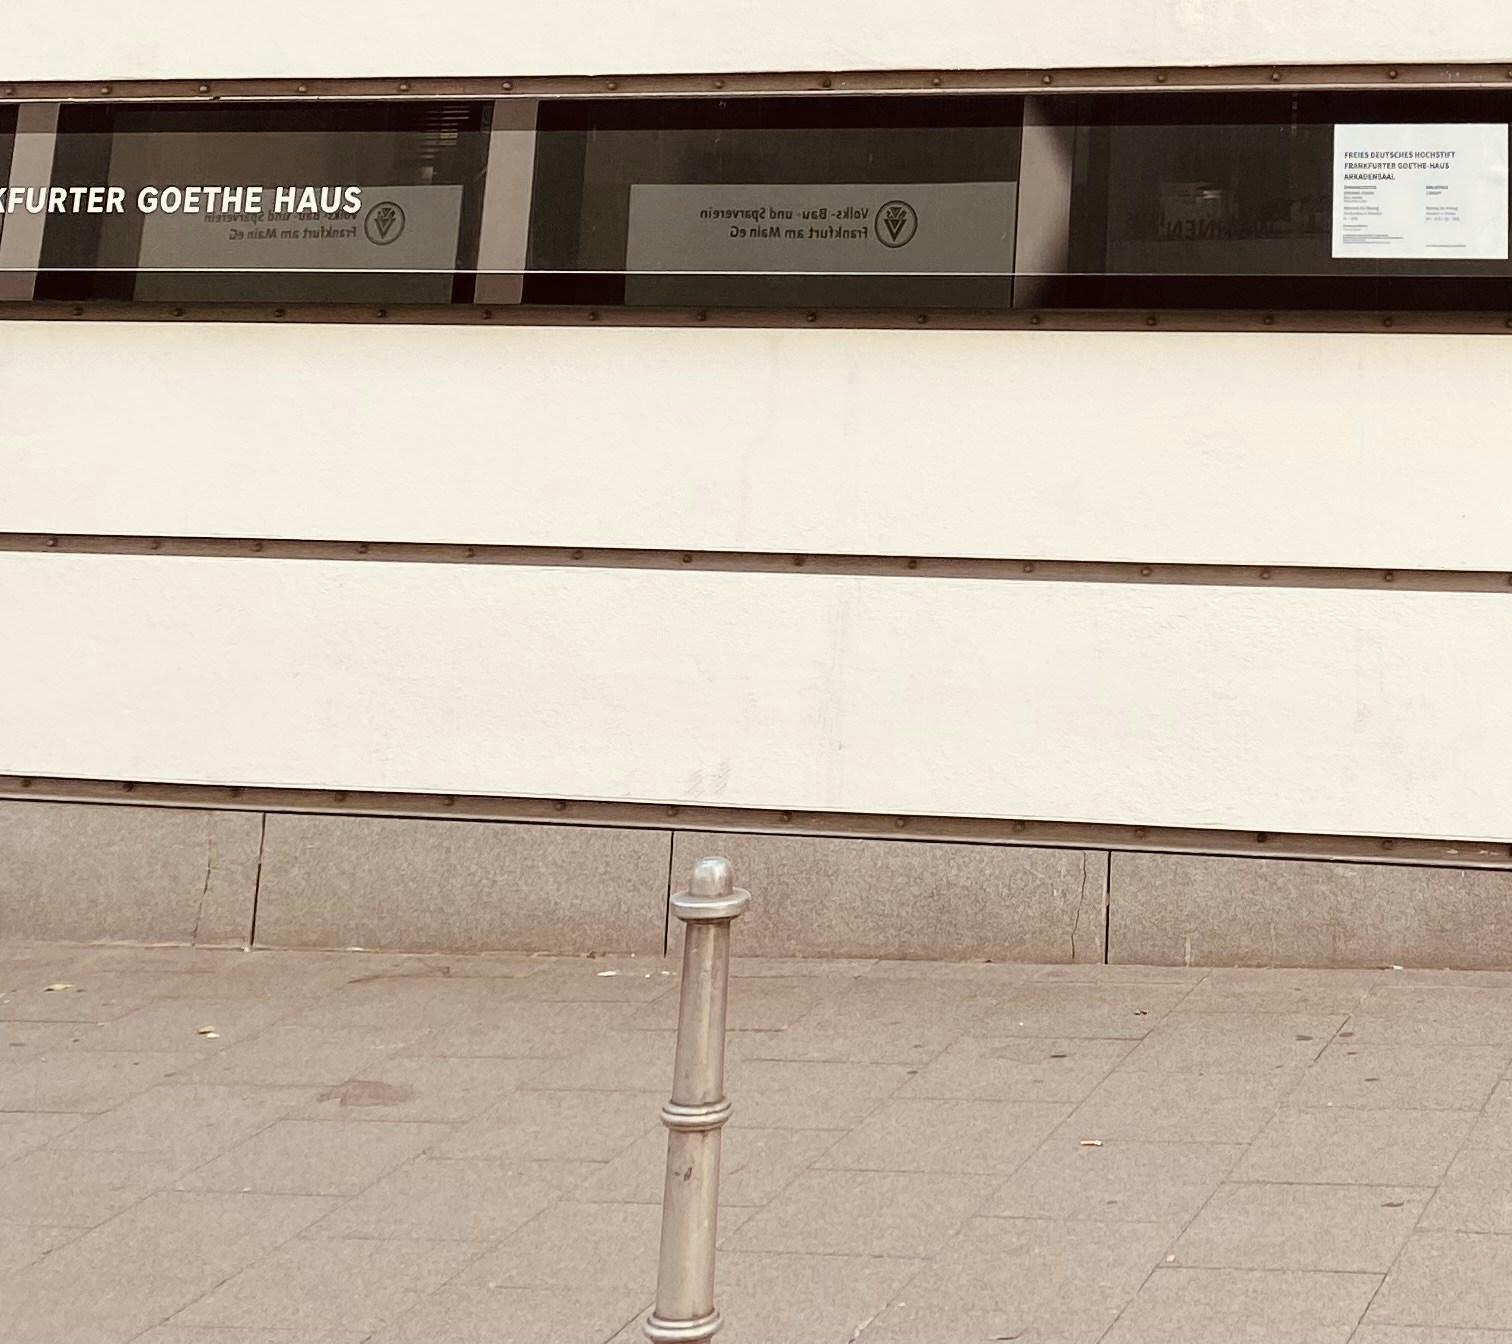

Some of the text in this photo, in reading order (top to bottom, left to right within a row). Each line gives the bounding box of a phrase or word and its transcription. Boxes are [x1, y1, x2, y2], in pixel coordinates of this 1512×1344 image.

[1344, 151, 1456, 159] FREIES DEUTSCHES HOCHSTIFT
[1397, 162, 1450, 170] GOETHE-HAUS
[137, 186, 263, 214] GOETHE
[274, 186, 362, 214] HAUS
